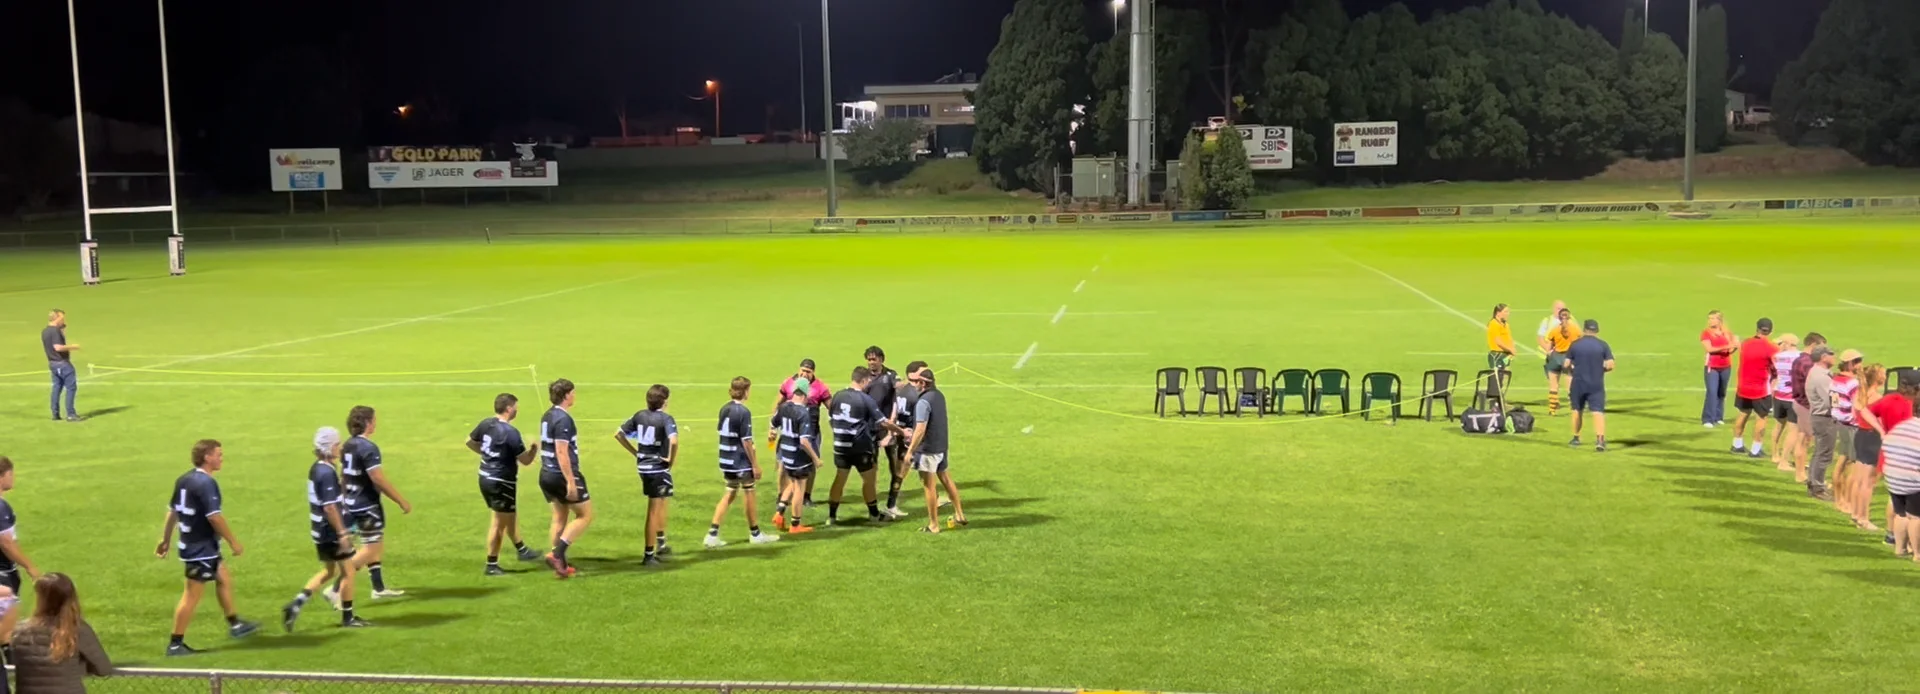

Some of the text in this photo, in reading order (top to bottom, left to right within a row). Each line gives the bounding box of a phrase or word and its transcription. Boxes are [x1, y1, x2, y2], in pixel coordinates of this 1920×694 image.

[1355, 127, 1396, 136] RANGERS
[1361, 138, 1390, 147] RUGBY
[392, 147, 483, 162] GOLD PARK
[428, 168, 464, 177] JAGER
